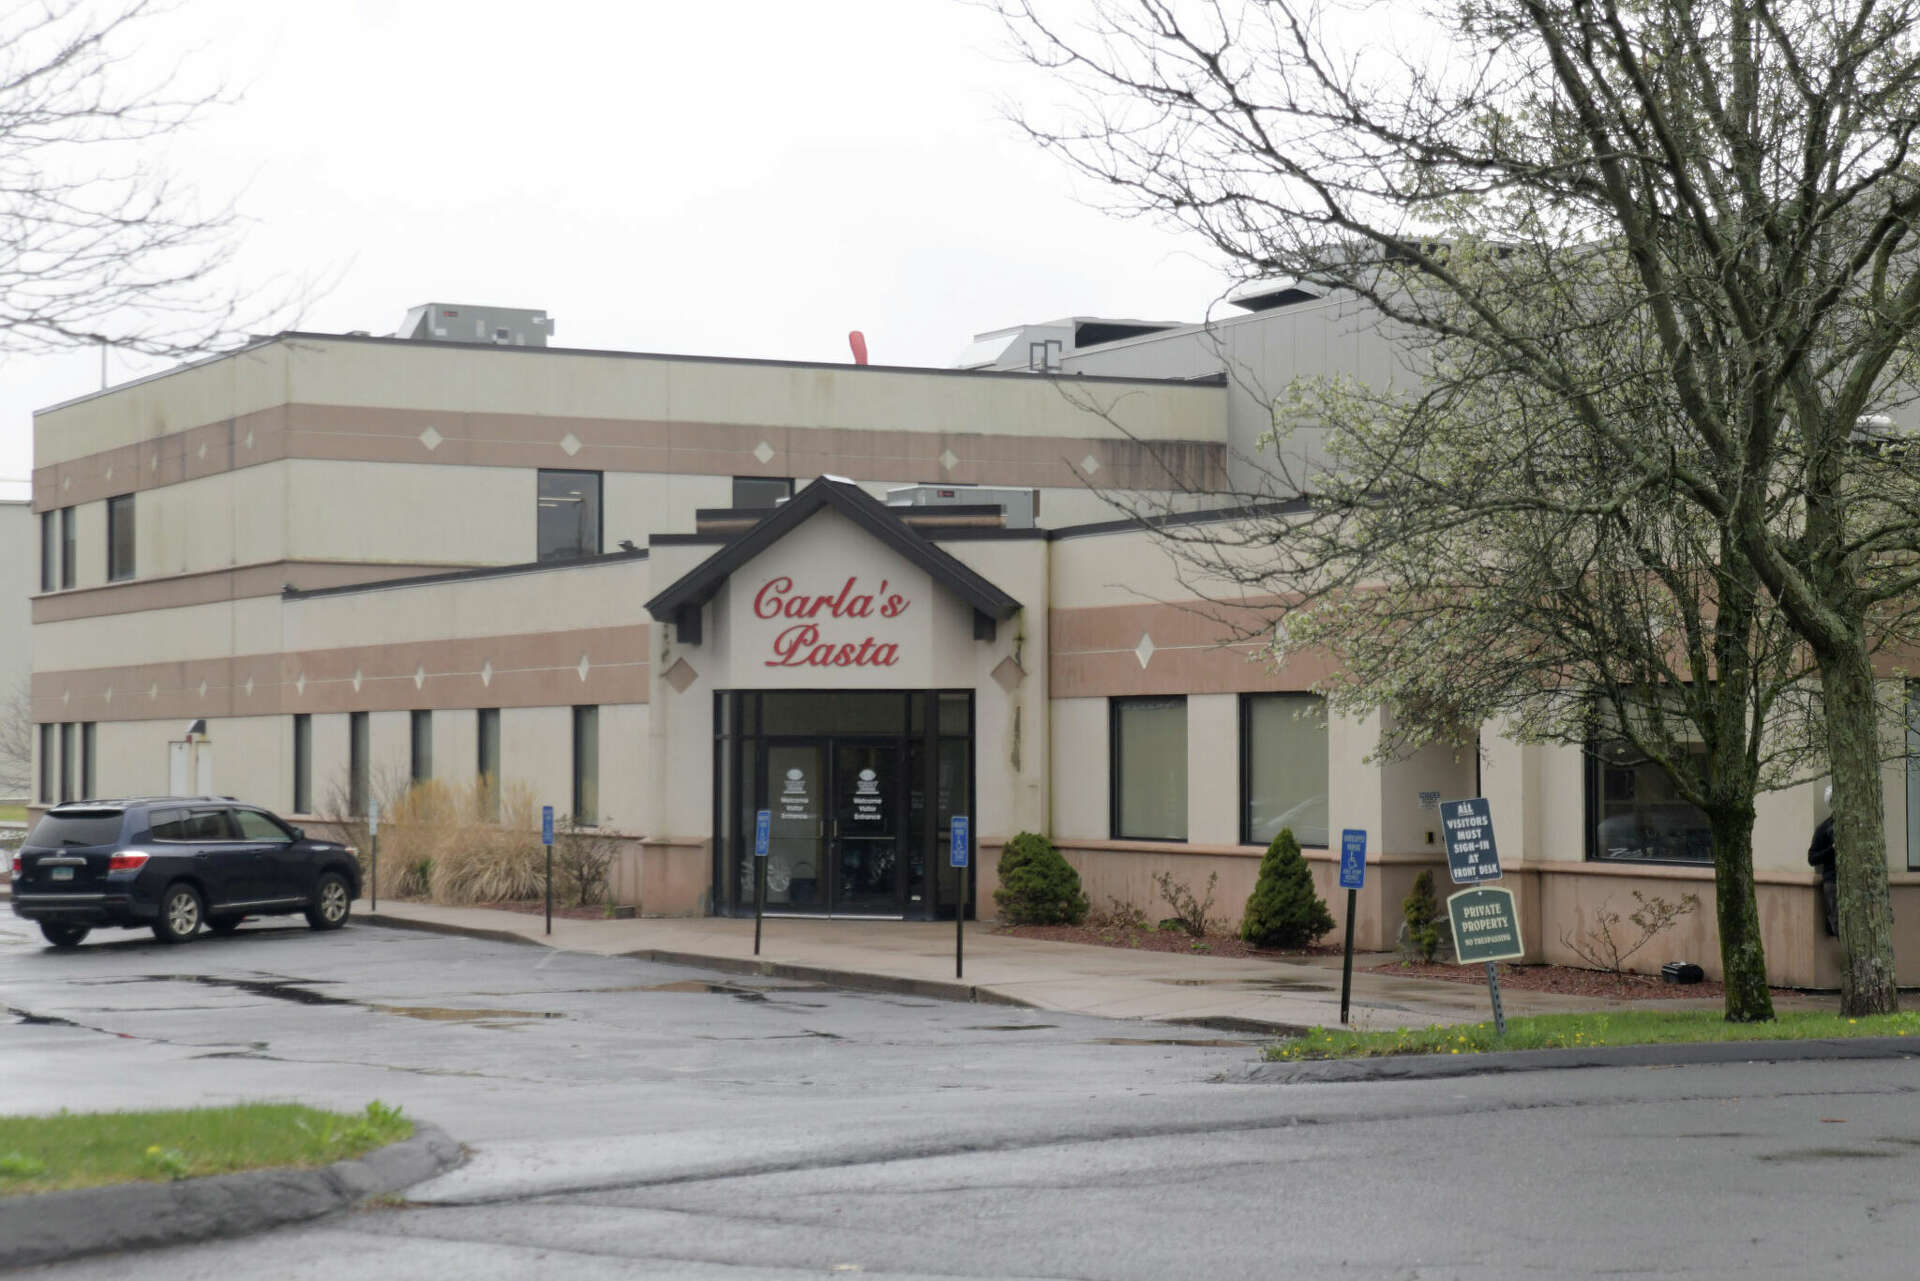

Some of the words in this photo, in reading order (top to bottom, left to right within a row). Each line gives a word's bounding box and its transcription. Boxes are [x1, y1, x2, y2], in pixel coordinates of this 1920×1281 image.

[754, 576, 910, 619] Carla's
[764, 623, 899, 667] Pasta
[1457, 802, 1474, 815] ALL
[1447, 815, 1489, 829] VISITORS
[1457, 828, 1482, 841] MUST
[1454, 840, 1490, 854] SIGN-IN
[1468, 853, 1480, 864] AT
[1453, 865, 1476, 878] FRONT
[1478, 863, 1498, 875] DESK
[1463, 903, 1502, 918] PRIVATE
[1461, 916, 1509, 932] PROPERTY
